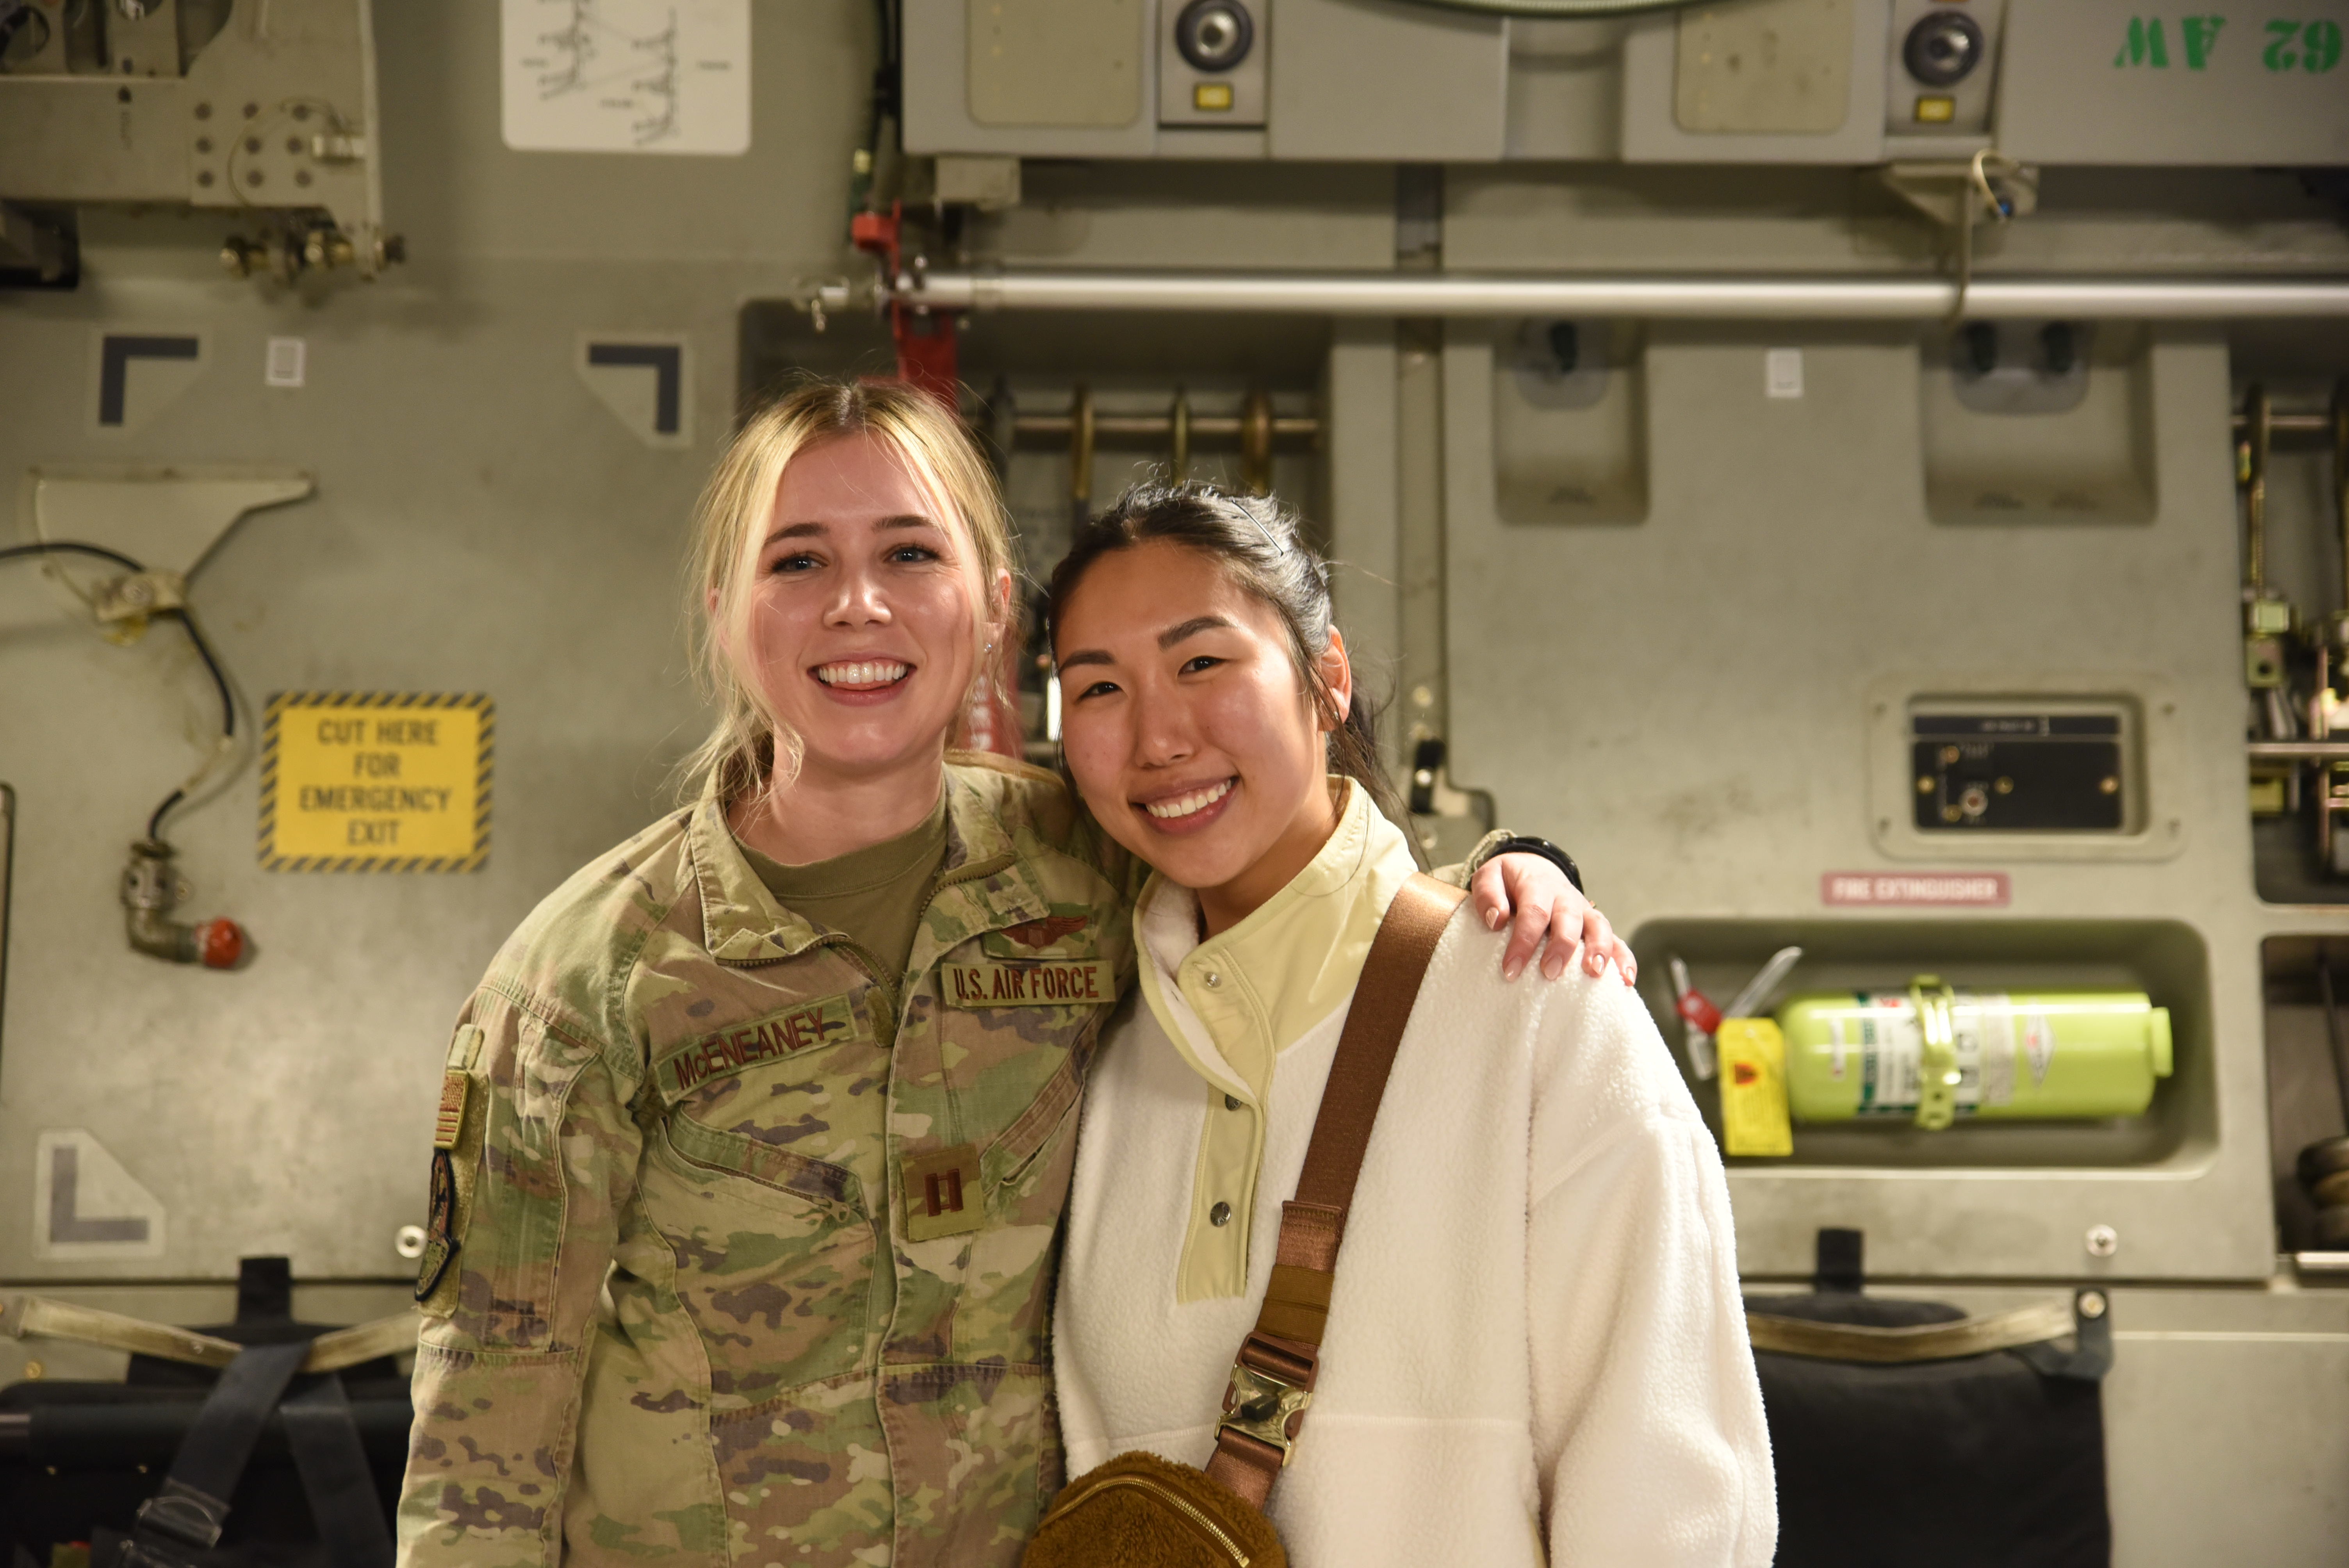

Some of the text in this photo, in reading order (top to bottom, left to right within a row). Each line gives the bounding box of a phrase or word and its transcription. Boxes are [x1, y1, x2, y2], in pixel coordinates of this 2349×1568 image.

[2112, 15, 2342, 72] 62 AW
[317, 718, 439, 746] CUT HERE
[354, 752, 401, 778] FOR
[299, 786, 451, 812] EMERGENCY
[348, 820, 400, 846] EXIT
[1832, 877, 1998, 900] FIRE EXTINGUISHER
[953, 966, 1099, 1000] U.S. AIR FORCE
[673, 1007, 825, 1090] McENEANEY
